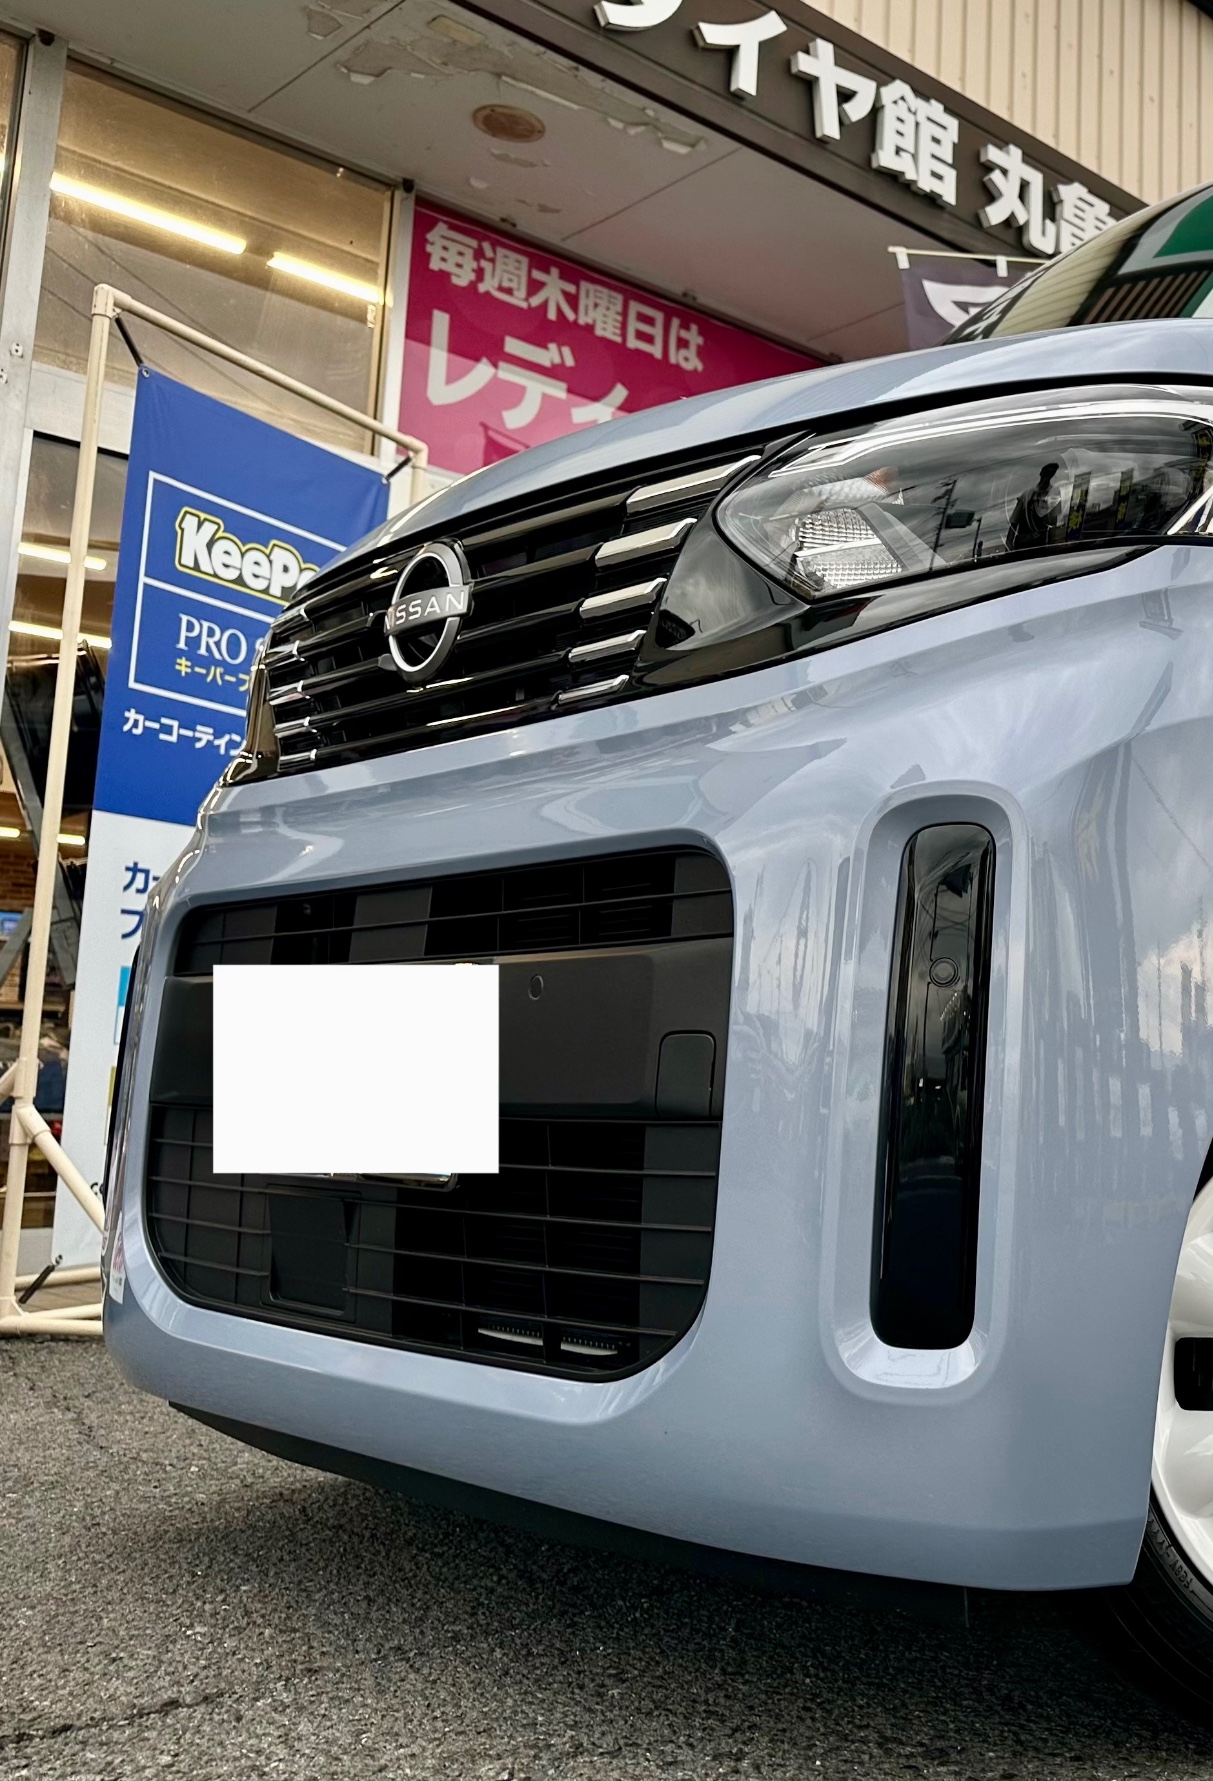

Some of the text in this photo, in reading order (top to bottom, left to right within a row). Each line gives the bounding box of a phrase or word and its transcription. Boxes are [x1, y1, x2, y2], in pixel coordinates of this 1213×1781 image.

[425, 221, 704, 372] 毎週木曜日は
[175, 613, 247, 665] PRO
